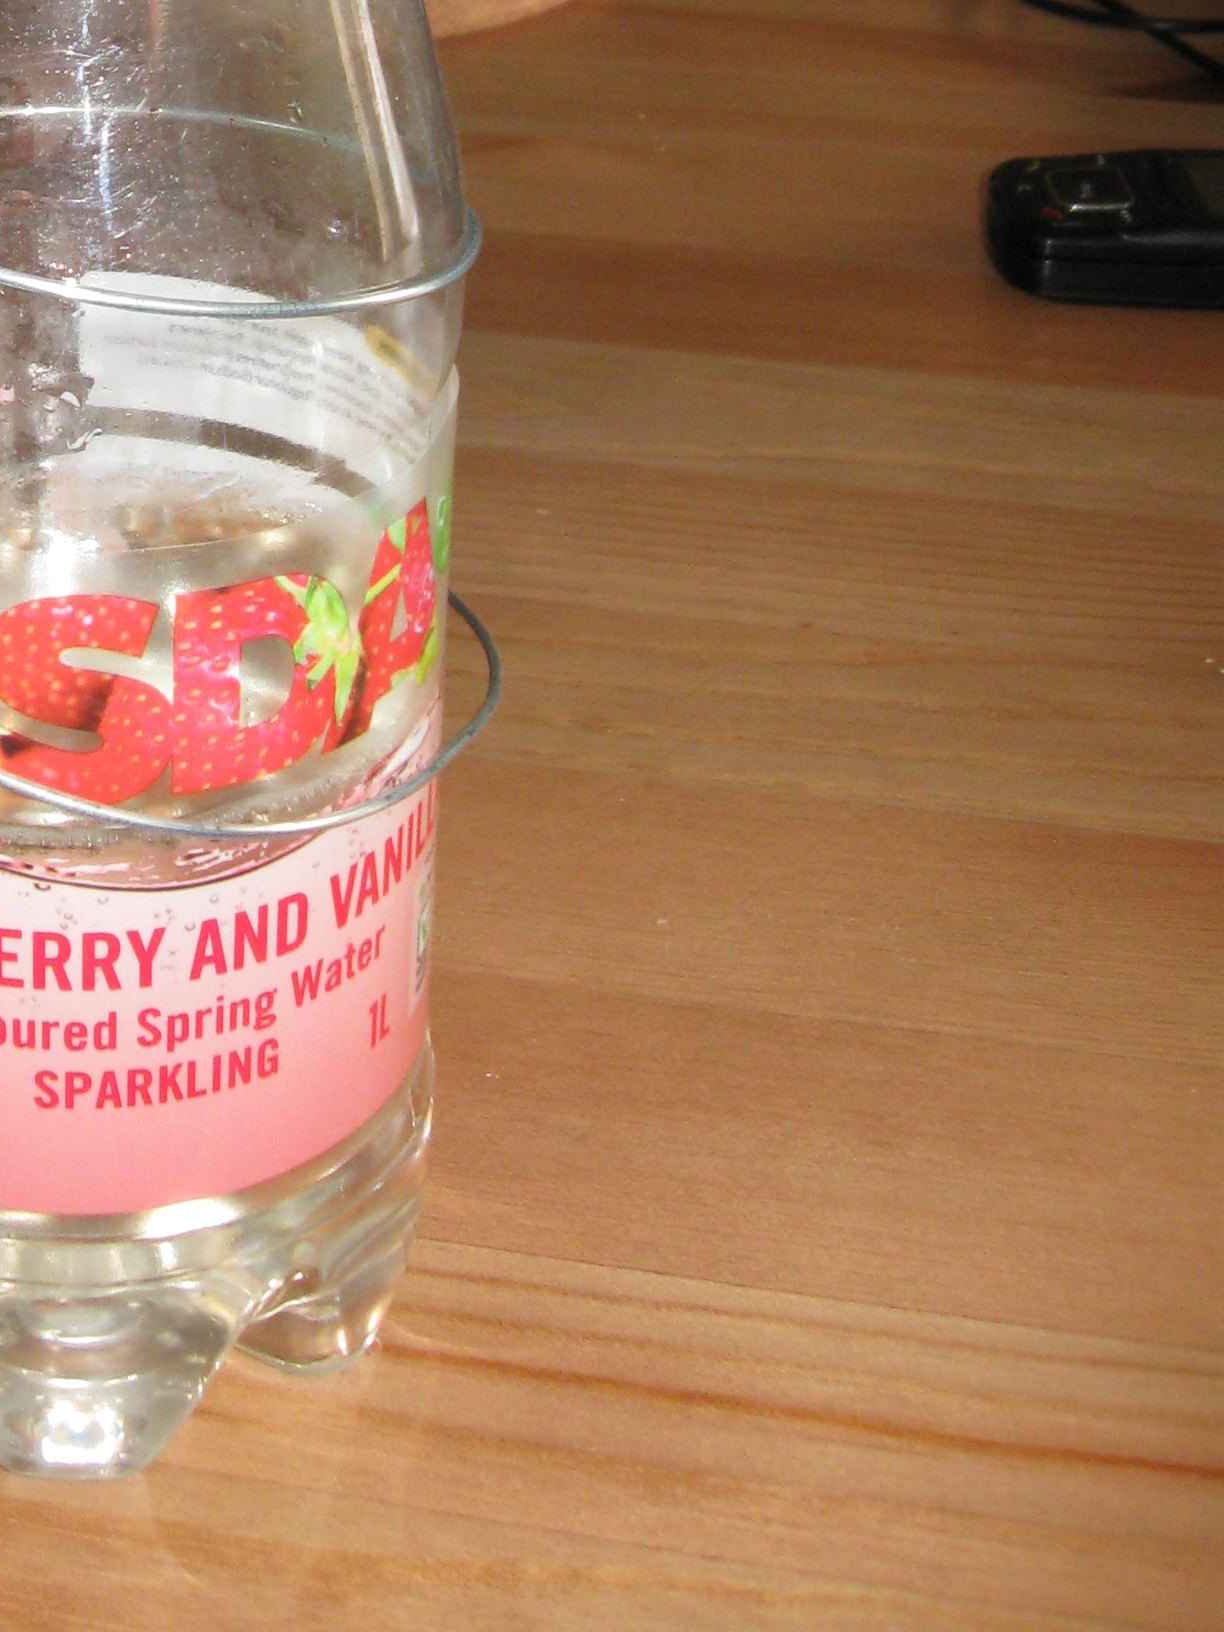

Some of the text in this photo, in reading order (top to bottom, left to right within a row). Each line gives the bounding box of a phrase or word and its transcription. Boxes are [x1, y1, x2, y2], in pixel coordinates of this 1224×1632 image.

[190, 892, 309, 979] AND
[330, 779, 438, 930] VANILL
[137, 987, 278, 1051] Spring
[291, 923, 386, 1006] Water
[368, 992, 391, 1050] 1L
[33, 1038, 280, 1110] SPARKLING
